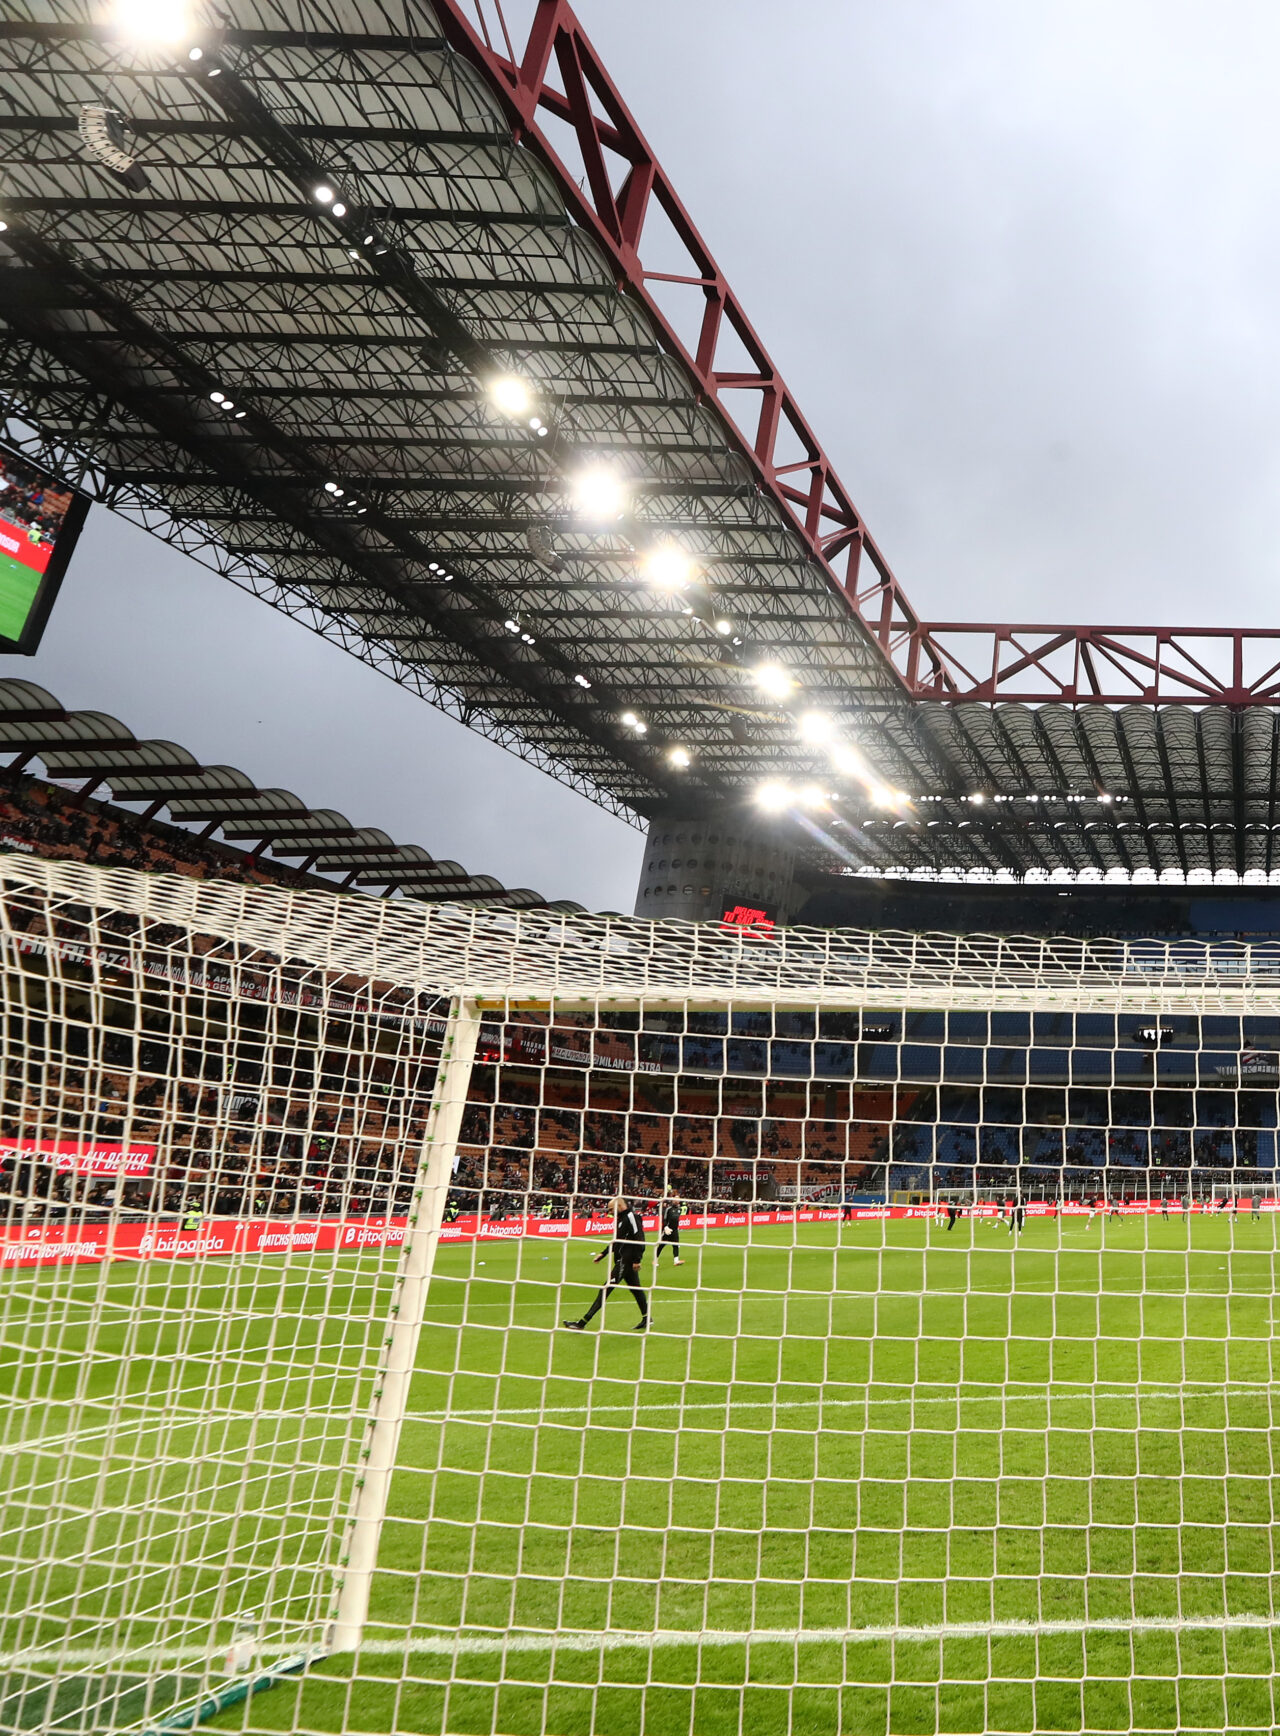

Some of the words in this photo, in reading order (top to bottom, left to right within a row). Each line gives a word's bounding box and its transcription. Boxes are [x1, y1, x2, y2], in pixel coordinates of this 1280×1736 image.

[723, 911, 735, 922] TO
[733, 905, 767, 919] WELCOME
[599, 1056, 624, 1070] MILAN
[81, 1151, 107, 1169] FLY
[591, 1220, 615, 1232] bitpand
[157, 1236, 224, 1252] bitpanda
